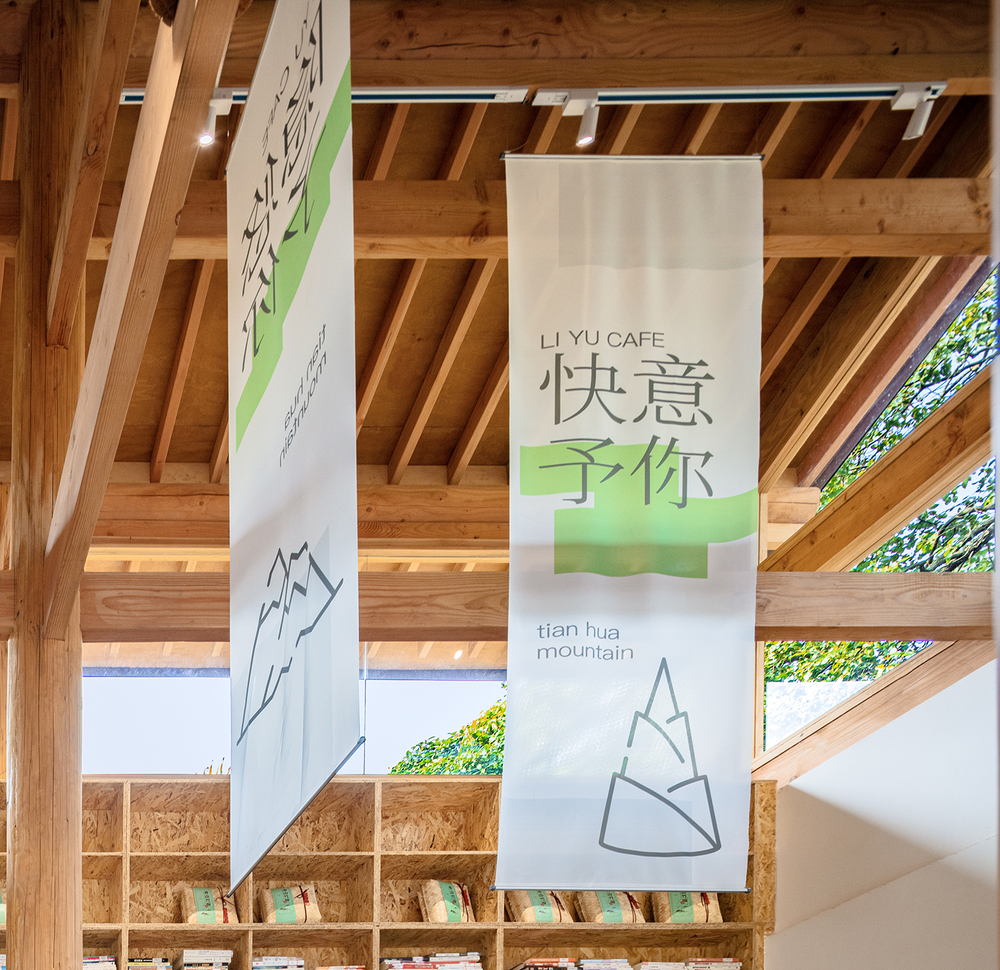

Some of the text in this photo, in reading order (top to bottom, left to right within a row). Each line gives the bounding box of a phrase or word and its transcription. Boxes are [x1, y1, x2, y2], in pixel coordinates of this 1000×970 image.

[540, 330, 665, 350] LI YU CAFE
[539, 352, 715, 426] 快意
[539, 435, 714, 509] 予你
[536, 621, 621, 641] tian hua
[536, 644, 634, 661] mountain
